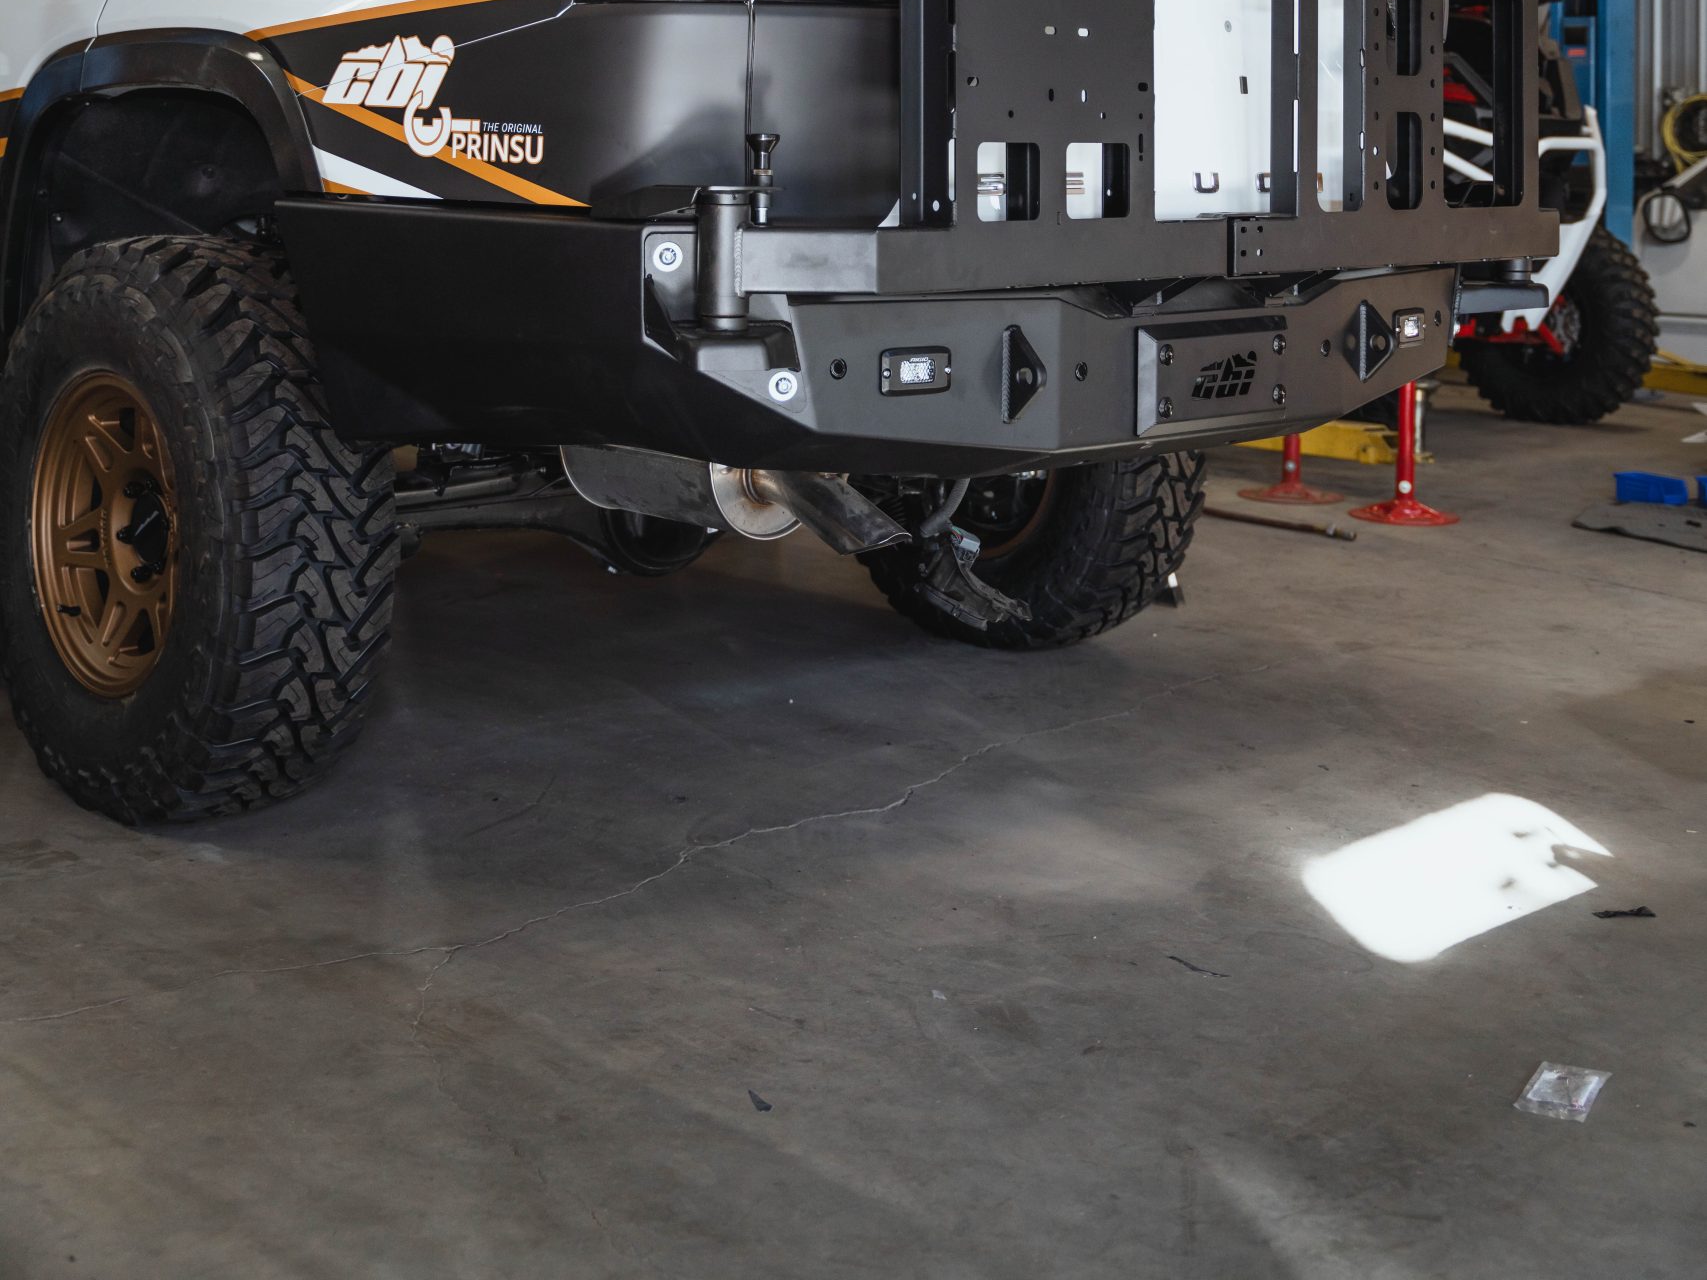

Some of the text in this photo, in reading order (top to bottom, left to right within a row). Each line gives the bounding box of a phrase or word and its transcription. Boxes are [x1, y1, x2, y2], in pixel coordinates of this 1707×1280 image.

[482, 121, 543, 134] THE ORIGINAL
[451, 132, 544, 165] PRINSU
